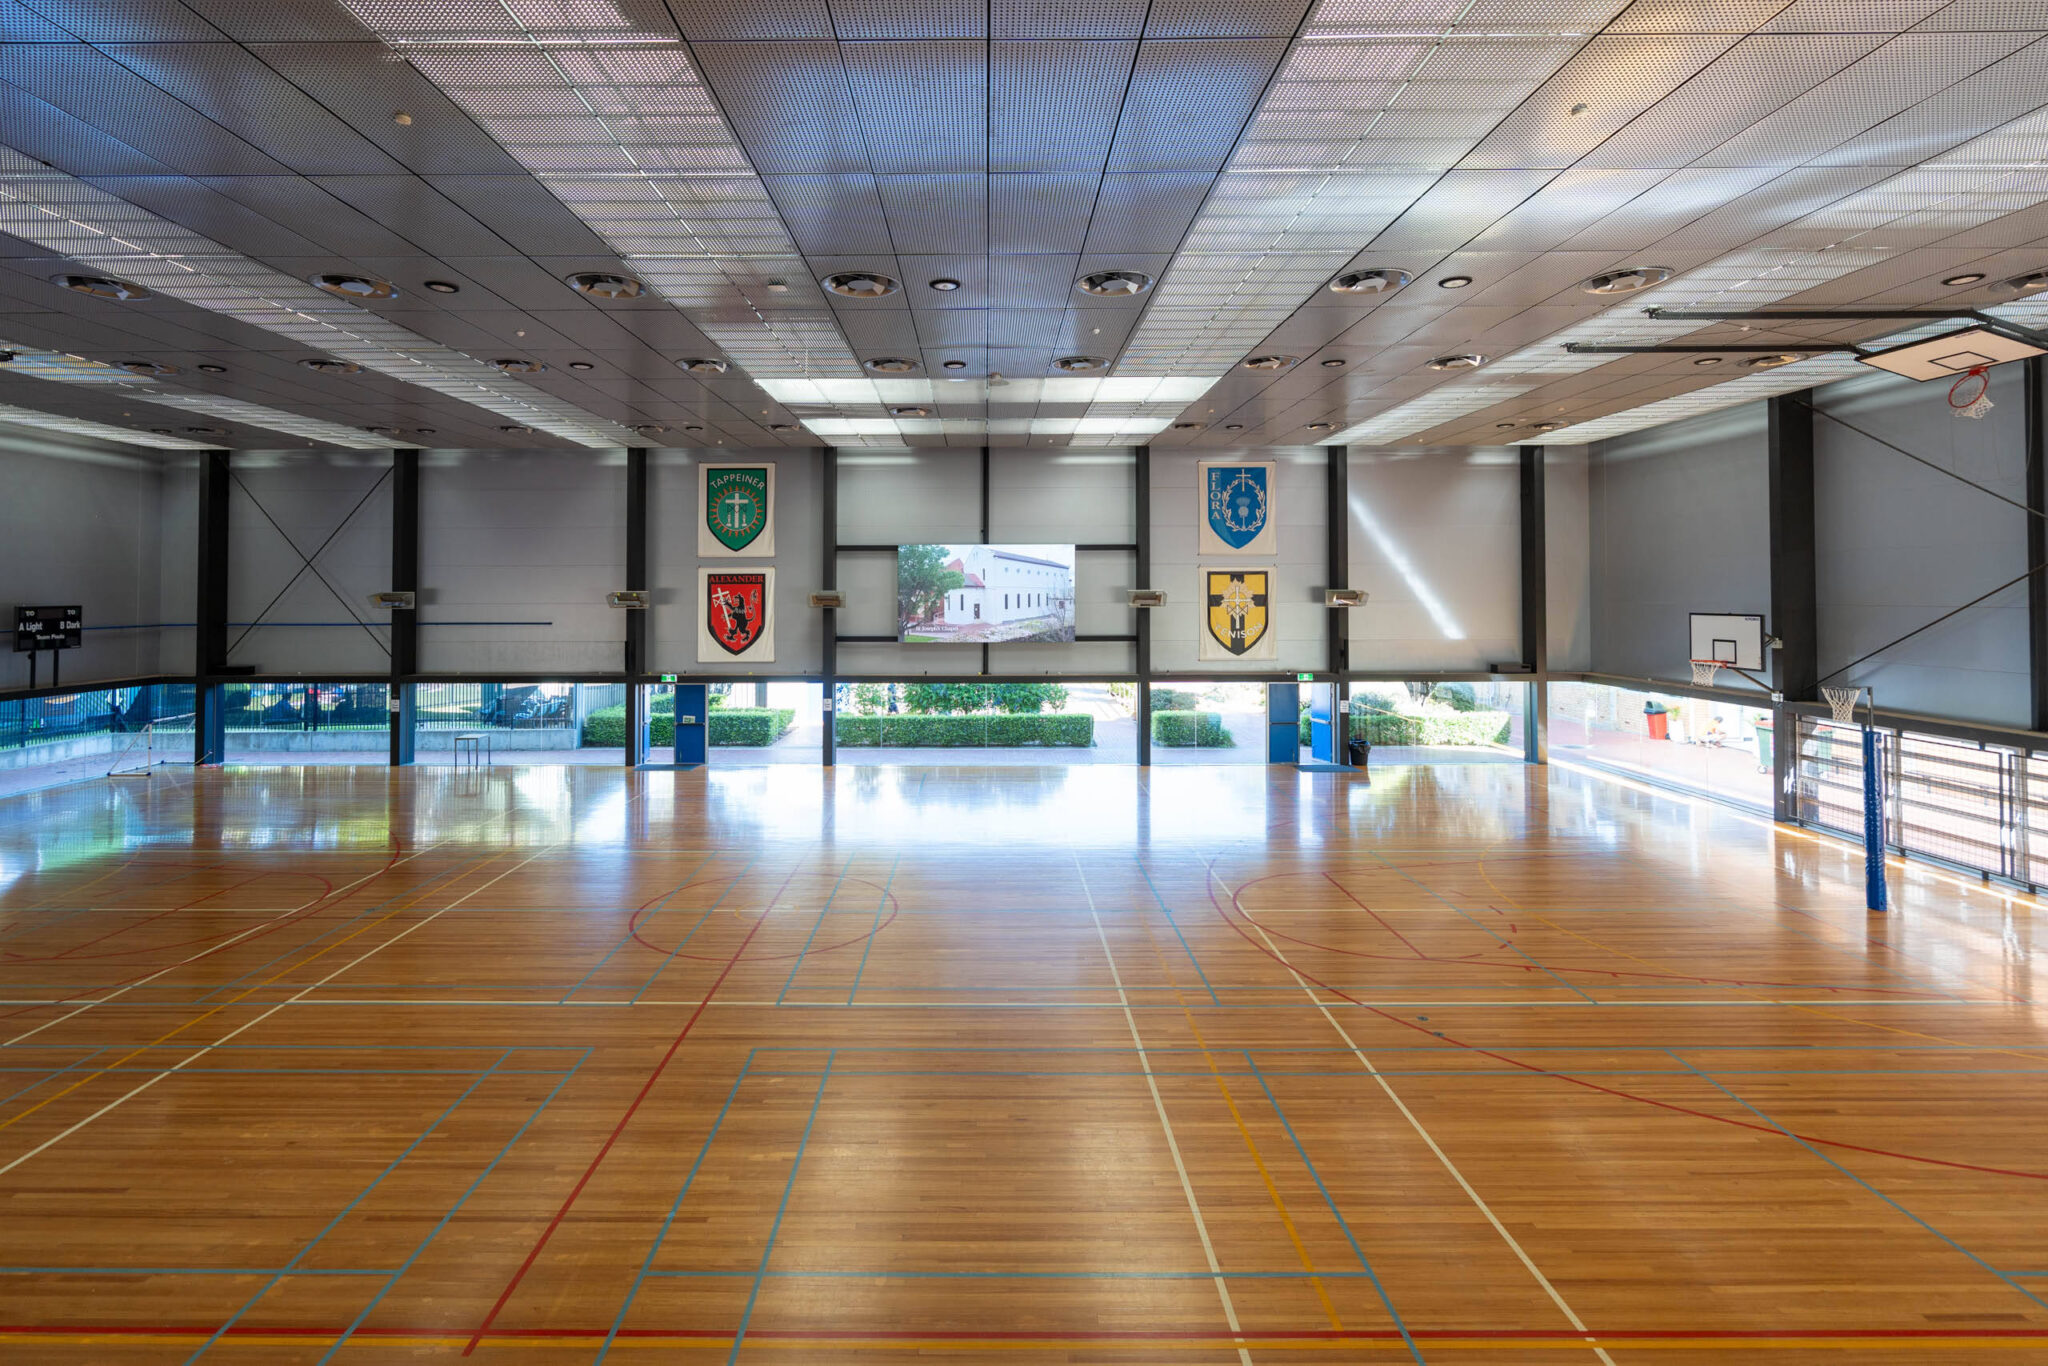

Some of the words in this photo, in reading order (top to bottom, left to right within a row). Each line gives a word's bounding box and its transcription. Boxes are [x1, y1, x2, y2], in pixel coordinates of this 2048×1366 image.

[710, 473, 765, 490] TAPPEINER
[1210, 472, 1221, 520] FLORA
[709, 575, 764, 583] ALEXANDER
[19, 622, 24, 631] A
[26, 622, 43, 632] Light
[66, 621, 80, 629] Dark
